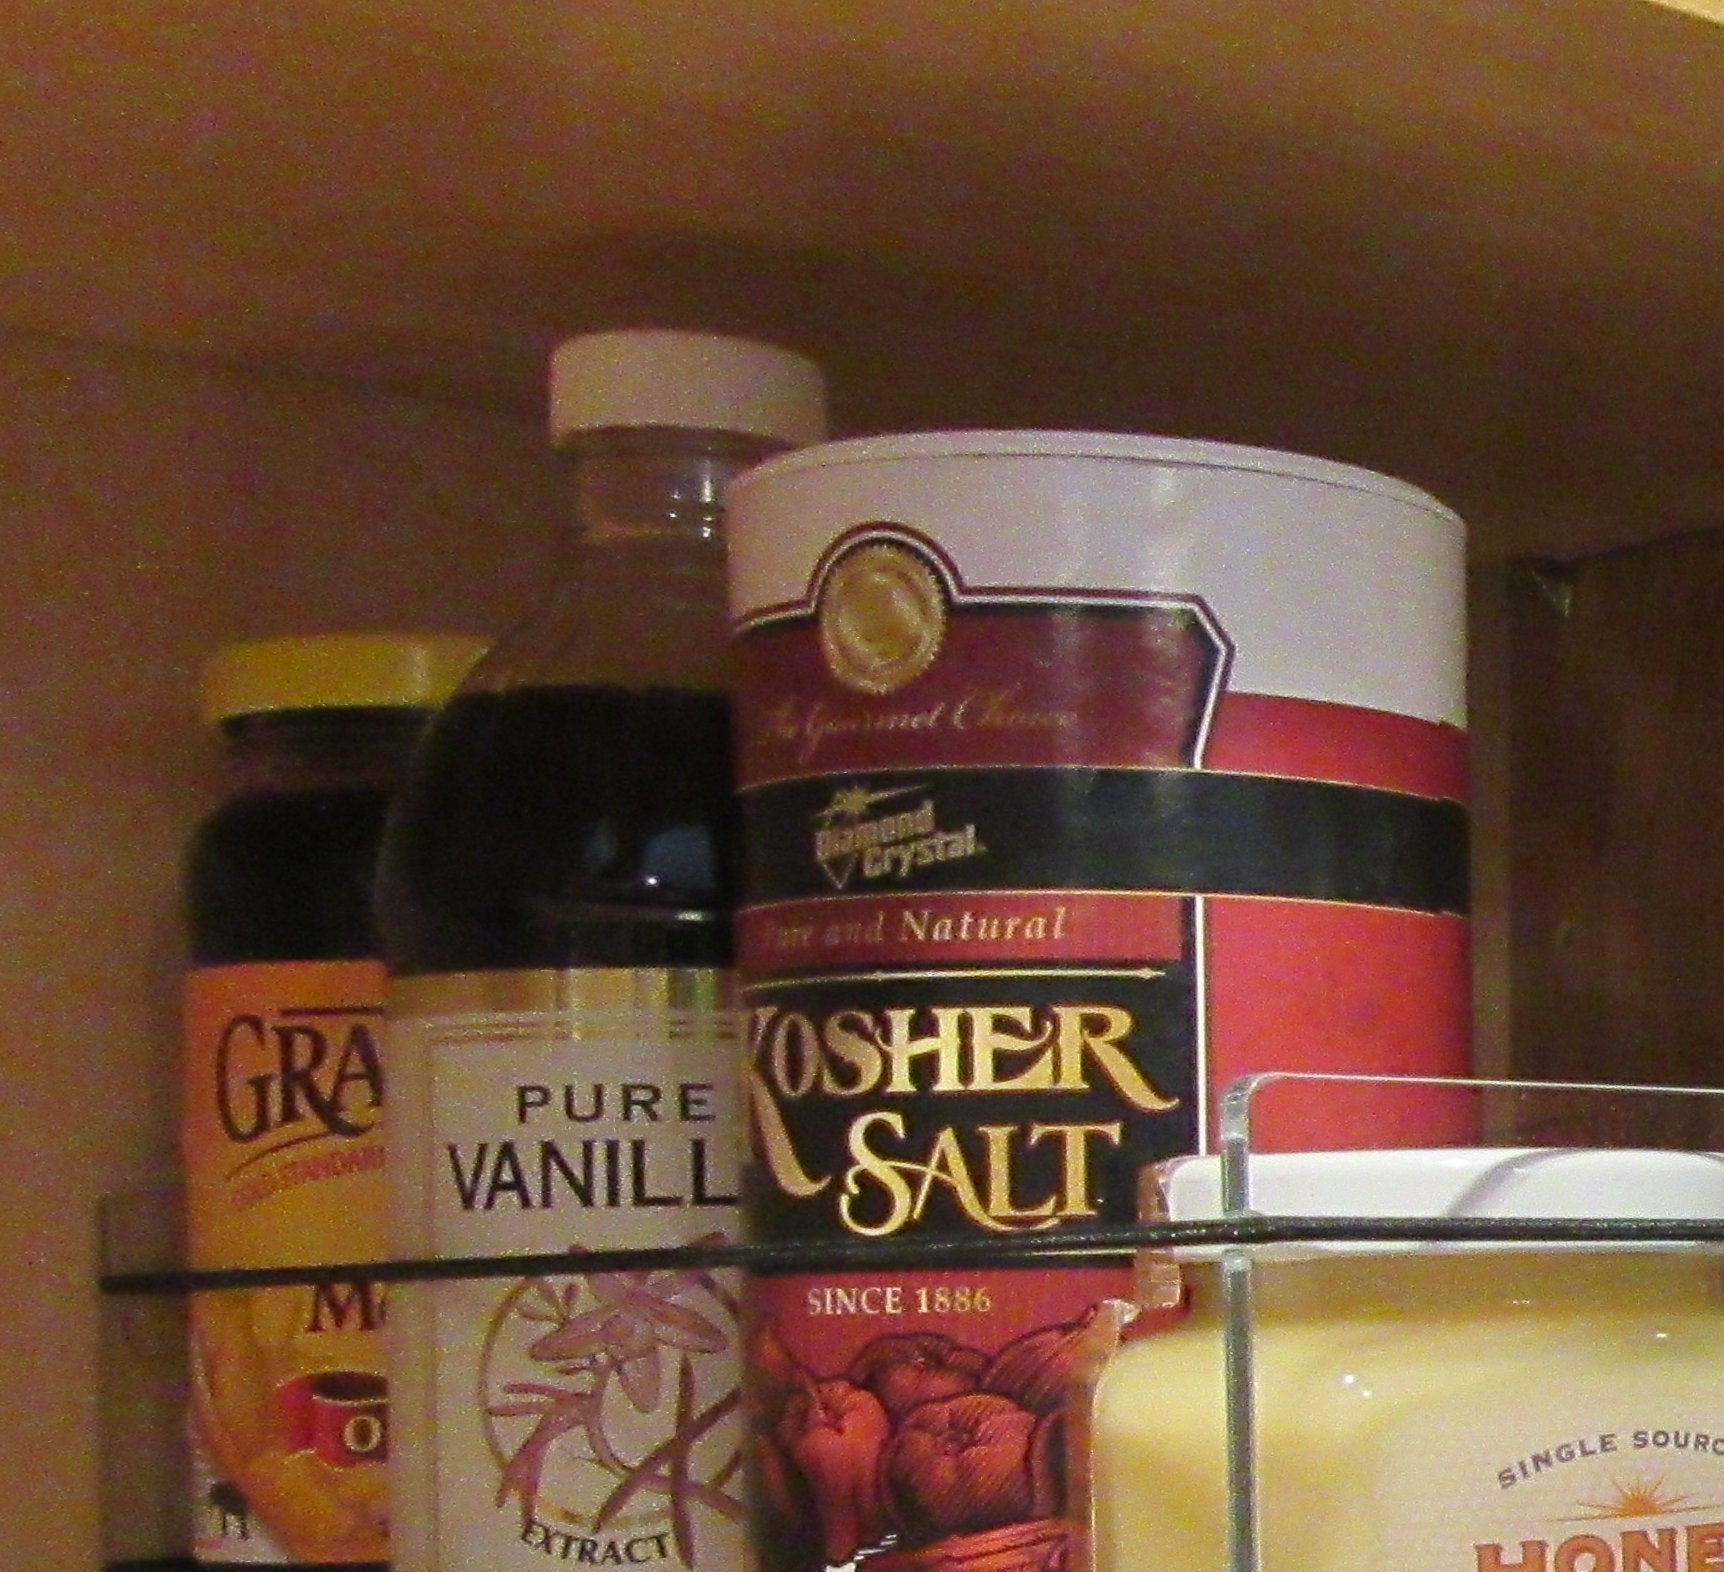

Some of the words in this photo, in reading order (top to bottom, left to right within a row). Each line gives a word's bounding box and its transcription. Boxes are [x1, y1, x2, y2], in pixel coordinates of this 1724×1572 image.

[815, 800, 935, 863] Diamond
[863, 824, 976, 880] Crystal
[825, 910, 885, 945] and
[902, 907, 1067, 943] Natural
[516, 1082, 717, 1124] PURE
[748, 1004, 1179, 1198] KOSHER
[447, 1138, 741, 1211] VANILL
[839, 1110, 1123, 1237] SALT
[807, 1286, 902, 1315] SINCE
[916, 1286, 991, 1314] 1886
[1497, 1432, 1619, 1488] SINGLE
[520, 1518, 670, 1566] EXTRACT
